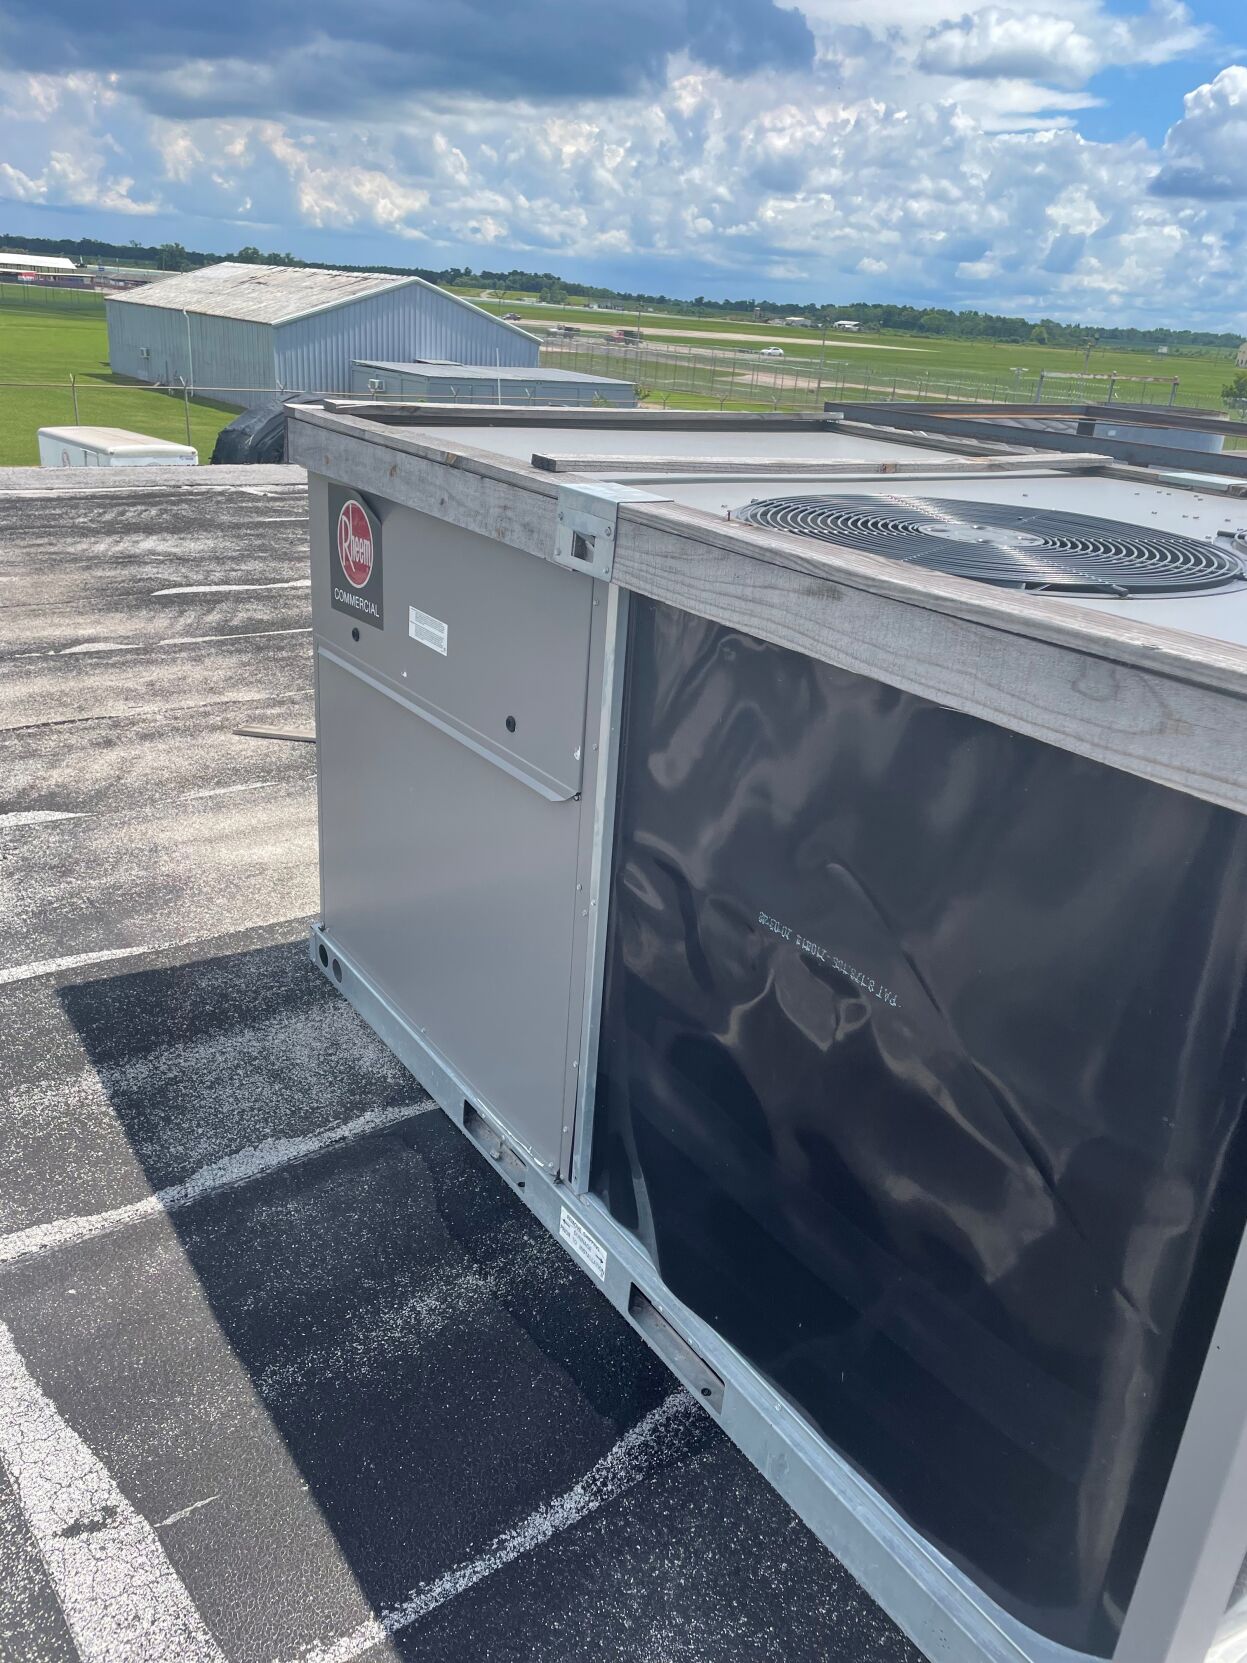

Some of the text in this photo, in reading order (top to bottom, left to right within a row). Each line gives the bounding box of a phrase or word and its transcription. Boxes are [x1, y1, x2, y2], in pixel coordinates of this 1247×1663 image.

[340, 502, 371, 572] Rheem
[334, 587, 380, 618] COMMERCIAL
[875, 985, 897, 1008] PAT
